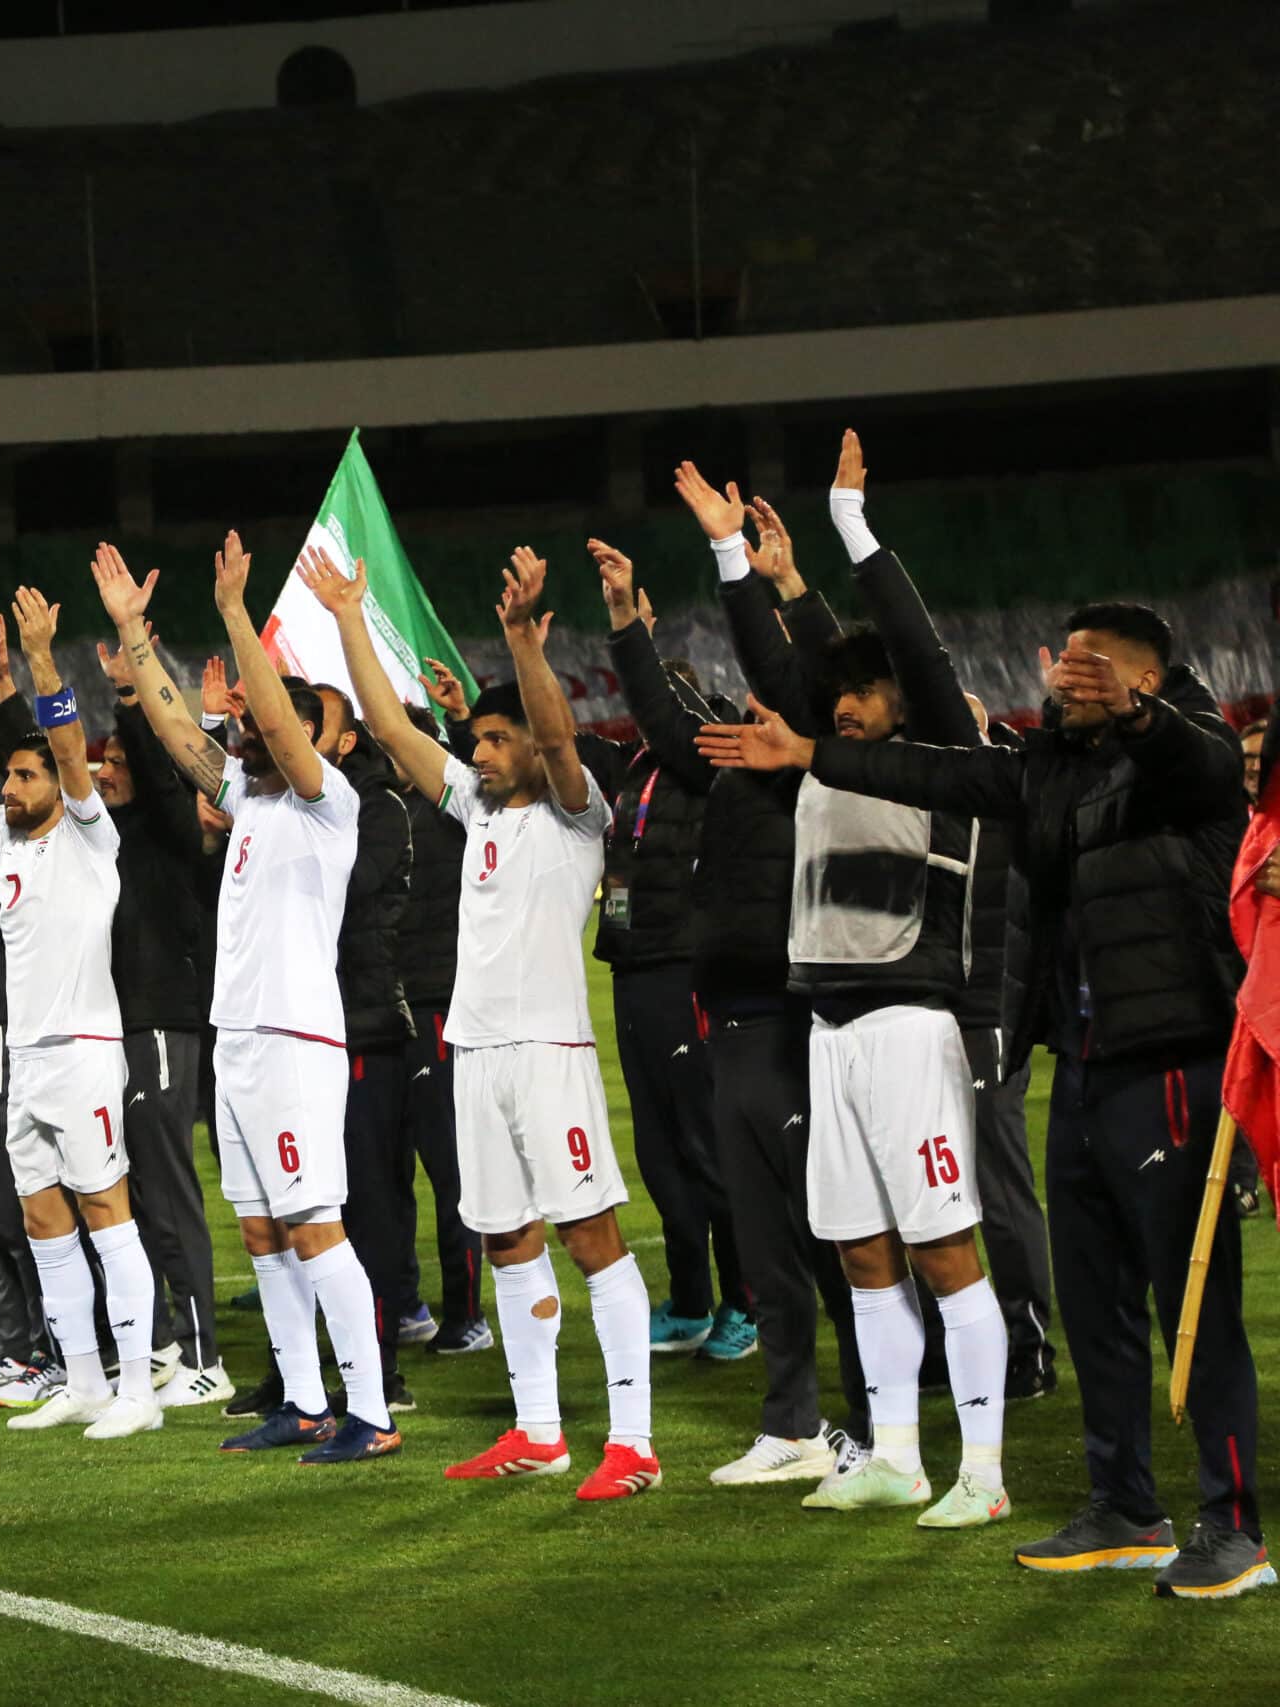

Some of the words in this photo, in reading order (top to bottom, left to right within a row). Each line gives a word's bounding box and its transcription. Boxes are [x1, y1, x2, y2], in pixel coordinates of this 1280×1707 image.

[479, 841, 498, 881] 9
[6, 873, 22, 910] 7
[277, 1130, 300, 1174] 6
[567, 1126, 592, 1173] 9
[917, 1135, 961, 1188] 15
